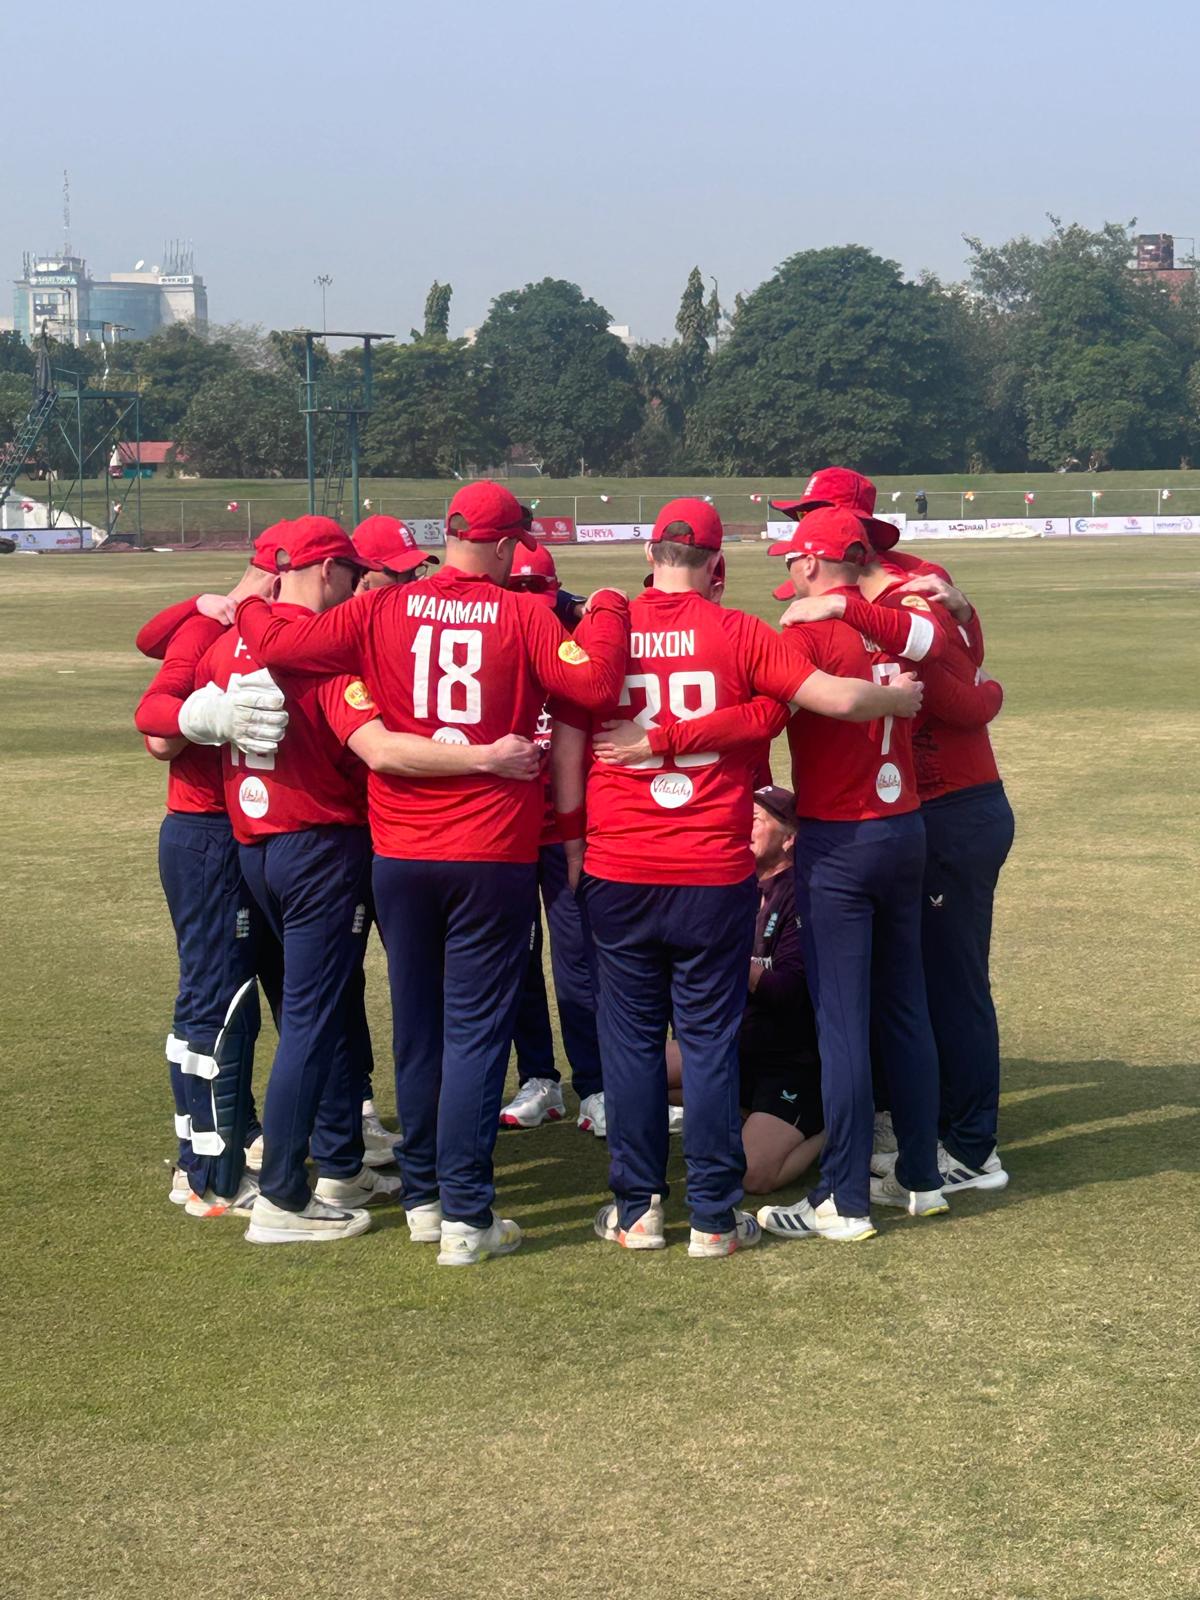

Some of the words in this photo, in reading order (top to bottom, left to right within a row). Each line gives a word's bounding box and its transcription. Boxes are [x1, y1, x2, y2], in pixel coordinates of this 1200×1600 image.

[580, 528, 614, 538] SURYA
[633, 526, 641, 537] 5
[1045, 520, 1053, 531] 5
[406, 594, 499, 625] WAINMAN
[630, 629, 695, 659] DIXON
[410, 625, 483, 725] 18
[653, 778, 691, 798] Vitality
